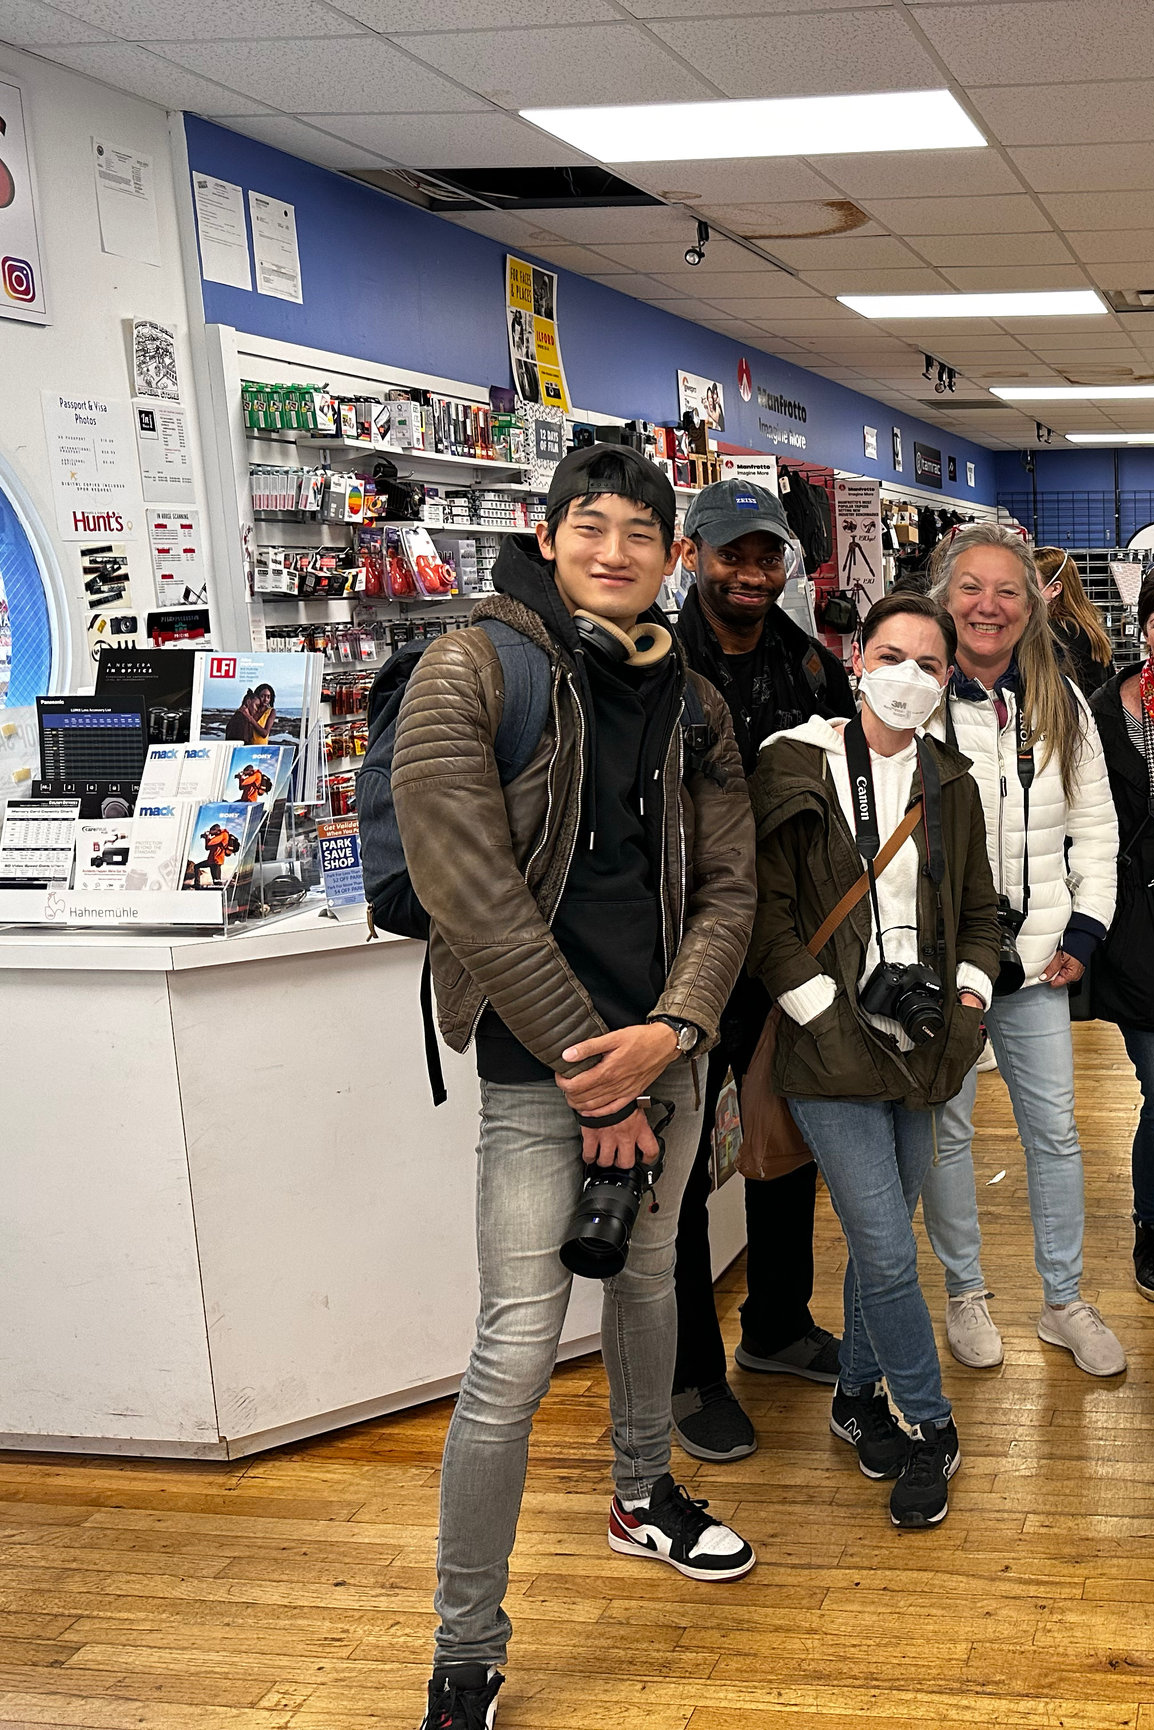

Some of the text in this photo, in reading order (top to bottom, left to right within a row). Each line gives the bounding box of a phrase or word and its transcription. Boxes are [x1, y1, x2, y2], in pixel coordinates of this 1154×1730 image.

[510, 267, 532, 286] FOR FACES
[516, 285, 532, 303] PLACES
[536, 330, 555, 347] ILFORD
[60, 397, 108, 413] Passport & Visa
[758, 386, 807, 423] Manfrotto
[75, 414, 97, 426] Photos
[540, 428, 559, 443] 12 DAYS
[759, 418, 807, 450] Imagine More
[547, 441, 559, 453] FILM
[921, 458, 941, 475] tamrac
[72, 511, 124, 532] Hunt's
[212, 660, 234, 676] LFI
[891, 700, 907, 710] 3M
[150, 748, 179, 760] mack
[856, 775, 870, 821] Canon
[139, 806, 176, 817] mack
[336, 822, 359, 830] Validat
[322, 838, 352, 851] PARK
[324, 848, 353, 860] SAVE
[324, 858, 355, 870] SHOP
[70, 907, 139, 919] Hahnemühle
[926, 982, 940, 991] Canon
